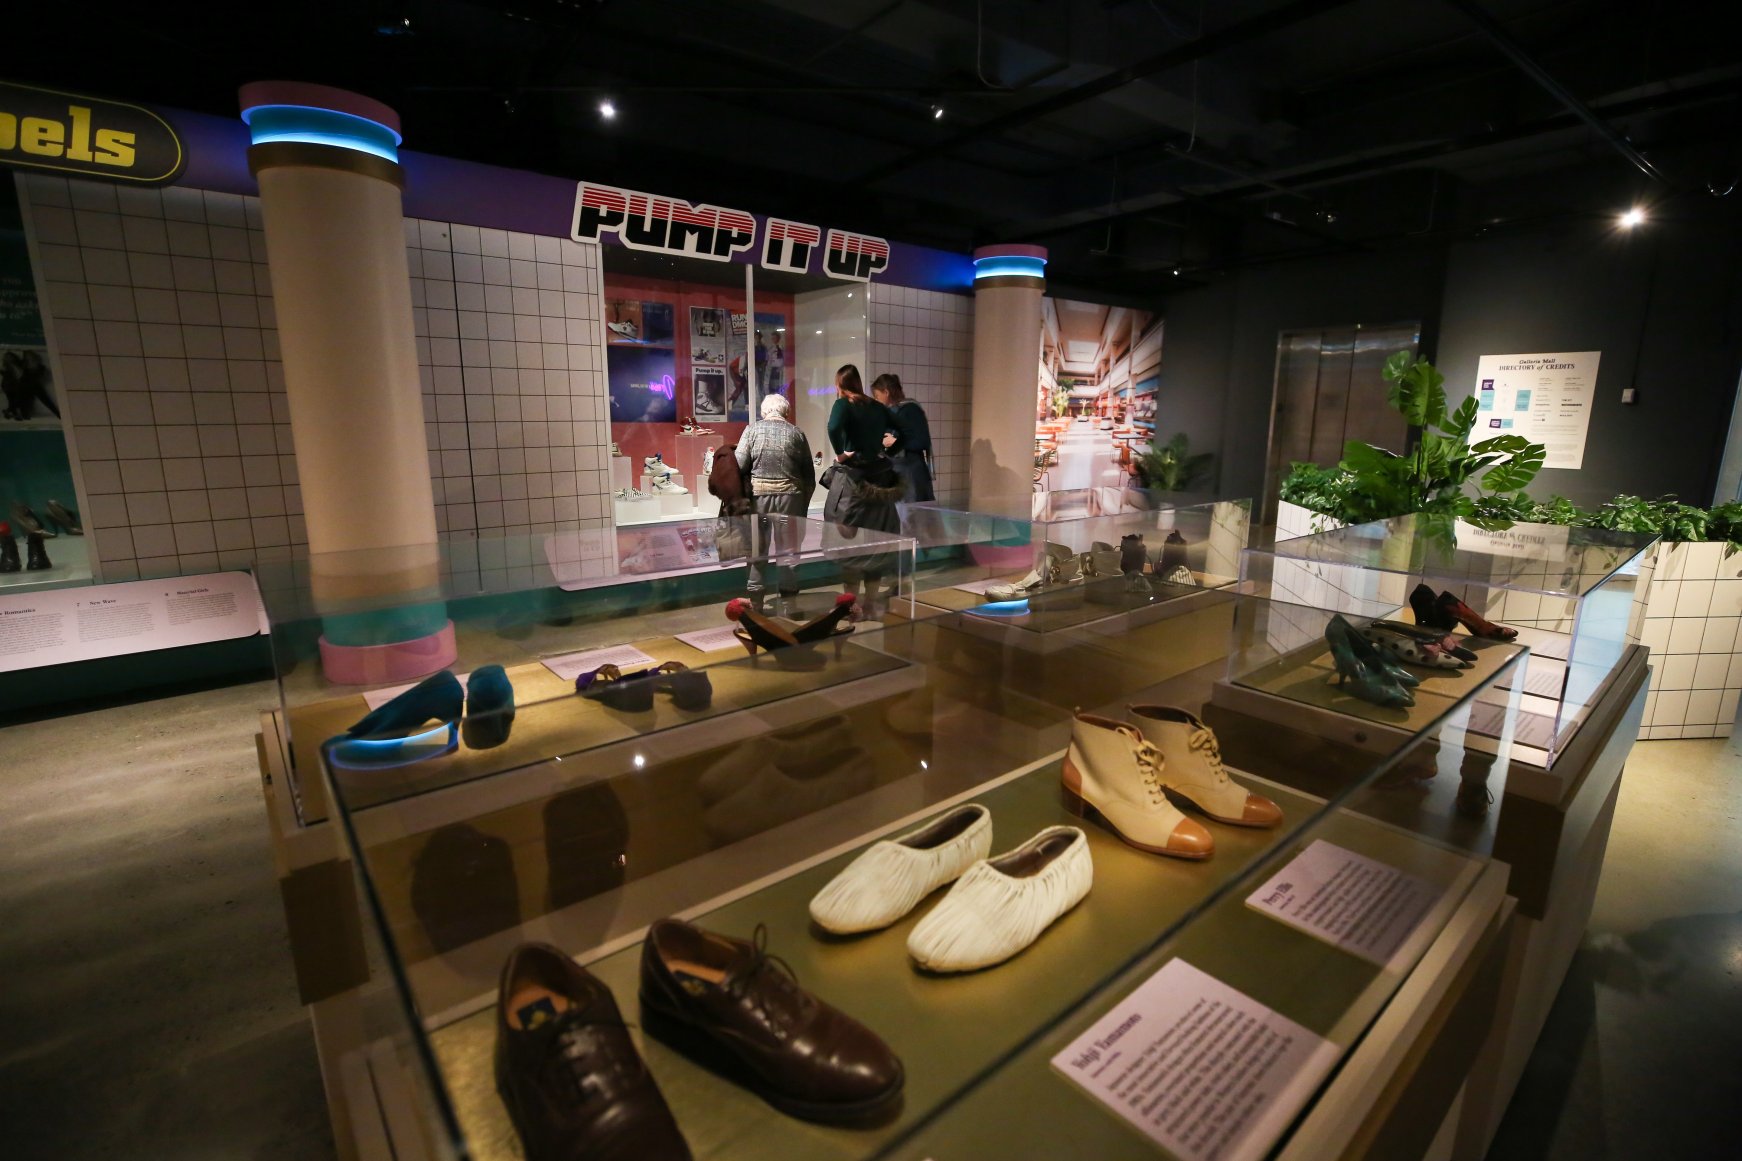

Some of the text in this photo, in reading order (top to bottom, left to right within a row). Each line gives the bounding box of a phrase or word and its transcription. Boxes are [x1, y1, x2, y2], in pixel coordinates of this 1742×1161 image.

[577, 185, 890, 279] PUMP IT UP
[1536, 364, 1544, 372] of
[1071, 1040, 1100, 1071] Yohji
[1097, 1013, 1143, 1050] Yamamoto
